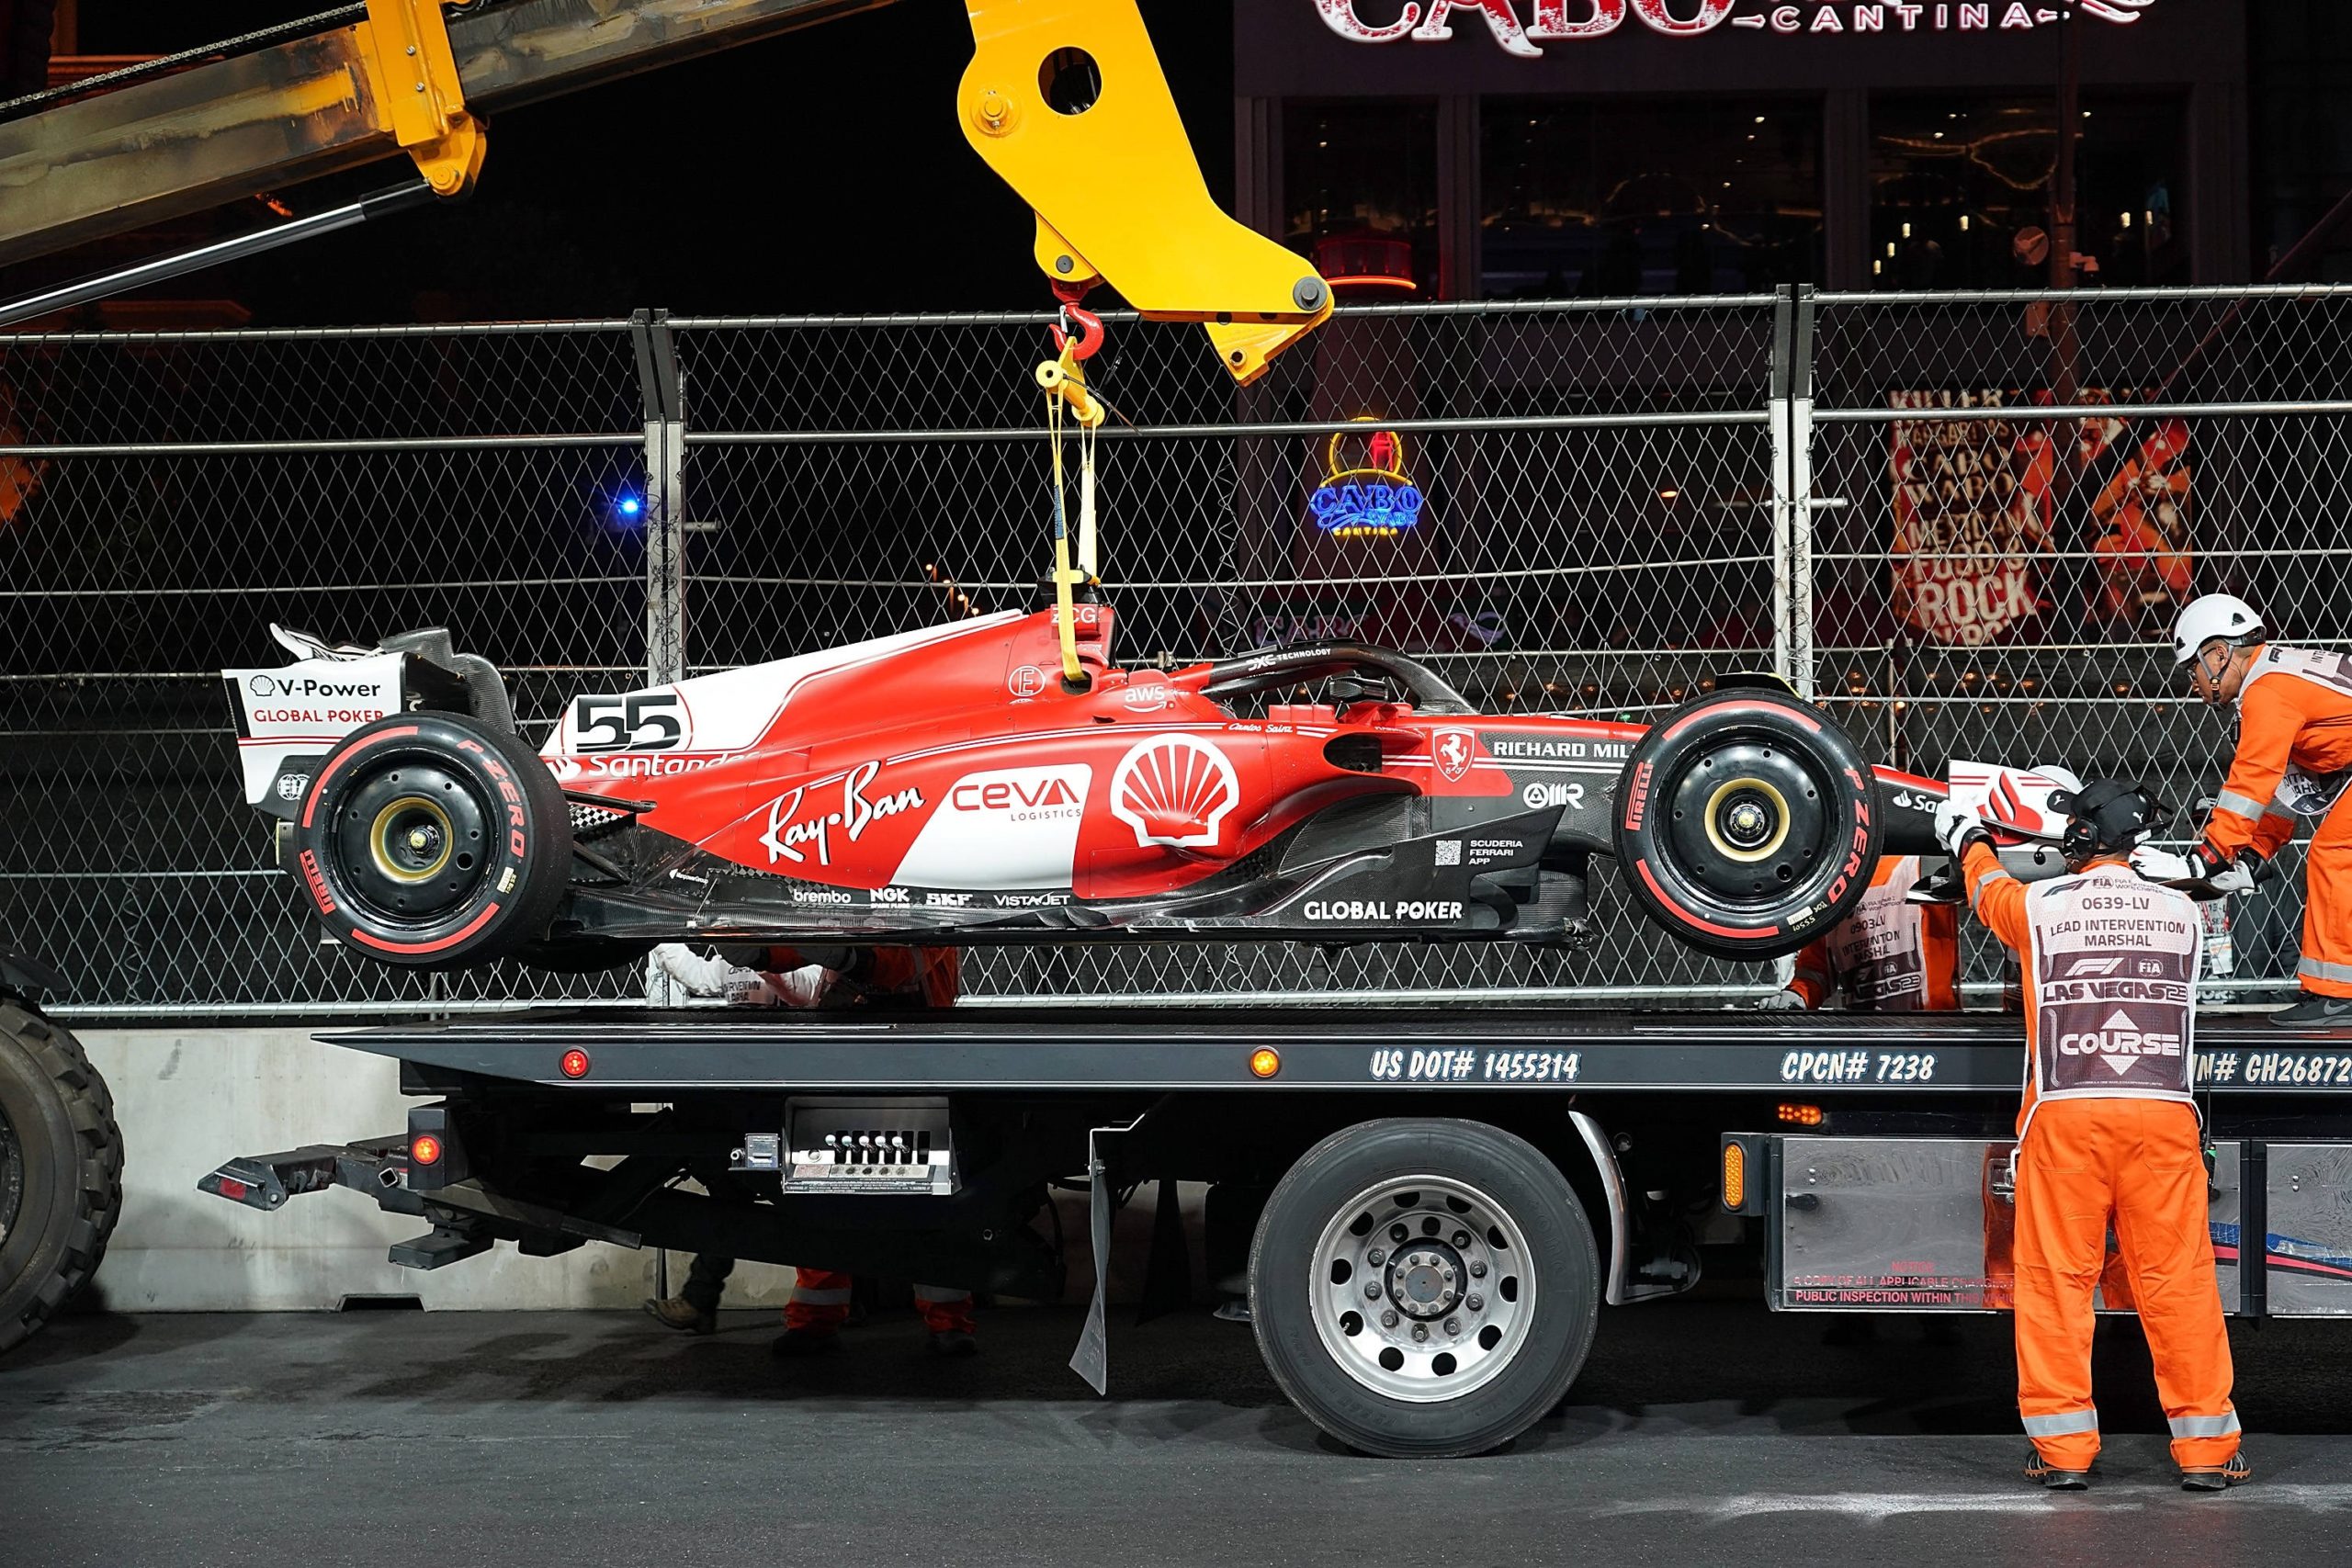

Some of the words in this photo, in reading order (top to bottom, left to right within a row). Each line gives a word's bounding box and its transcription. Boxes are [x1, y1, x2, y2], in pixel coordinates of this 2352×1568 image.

[1771, 3, 2034, 31] CANTINA
[1310, 485, 1423, 514] CABO
[1917, 571, 2036, 628] ROCK
[1278, 648, 1331, 662] TECHNOLOGY
[277, 679, 381, 697] V-Power
[1125, 685, 1165, 703] aws
[254, 709, 322, 723] GLOBAL
[328, 709, 384, 723] POKER
[576, 694, 682, 753] 55
[1493, 741, 1586, 758] RICHARD
[1593, 743, 1634, 759] MIL
[1845, 768, 1864, 792] P
[457, 739, 485, 755] P
[481, 760, 526, 859] ZERO
[1625, 761, 1654, 831] PIRELLI
[1011, 808, 1082, 821] LOGISTICS
[1470, 840, 1523, 848] SCUDERIA
[1827, 798, 1870, 905] ZERO
[300, 849, 337, 916] PIRELLI
[794, 889, 852, 905] brembo
[870, 888, 910, 903] NGK
[925, 893, 973, 907] SKF
[993, 891, 1071, 907] VISTAJET
[2082, 897, 2150, 909] 0639-LV
[1303, 901, 1391, 920] GLOBAL
[1396, 901, 1463, 919] POKER
[2051, 920, 2082, 936] LEAD
[2086, 919, 2186, 934] INTERVENTION
[2084, 935, 2153, 946] MARSHAL
[2138, 962, 2162, 974] FIA
[2043, 982, 2085, 1003] LAS
[2060, 1031, 2181, 1056] COURSE
[1372, 1050, 1404, 1077] US
[1409, 1050, 1476, 1077] DOT#
[1485, 1053, 1580, 1079] 1455314
[1782, 1052, 1869, 1080] CPCN#
[1877, 1055, 1935, 1080] 7238
[1796, 1291, 1837, 1302] PUBLIC
[1839, 1292, 1908, 1303] INSPECTION
[1912, 1292, 1951, 1303] WITHIN
[1954, 1292, 1979, 1303] THIS
